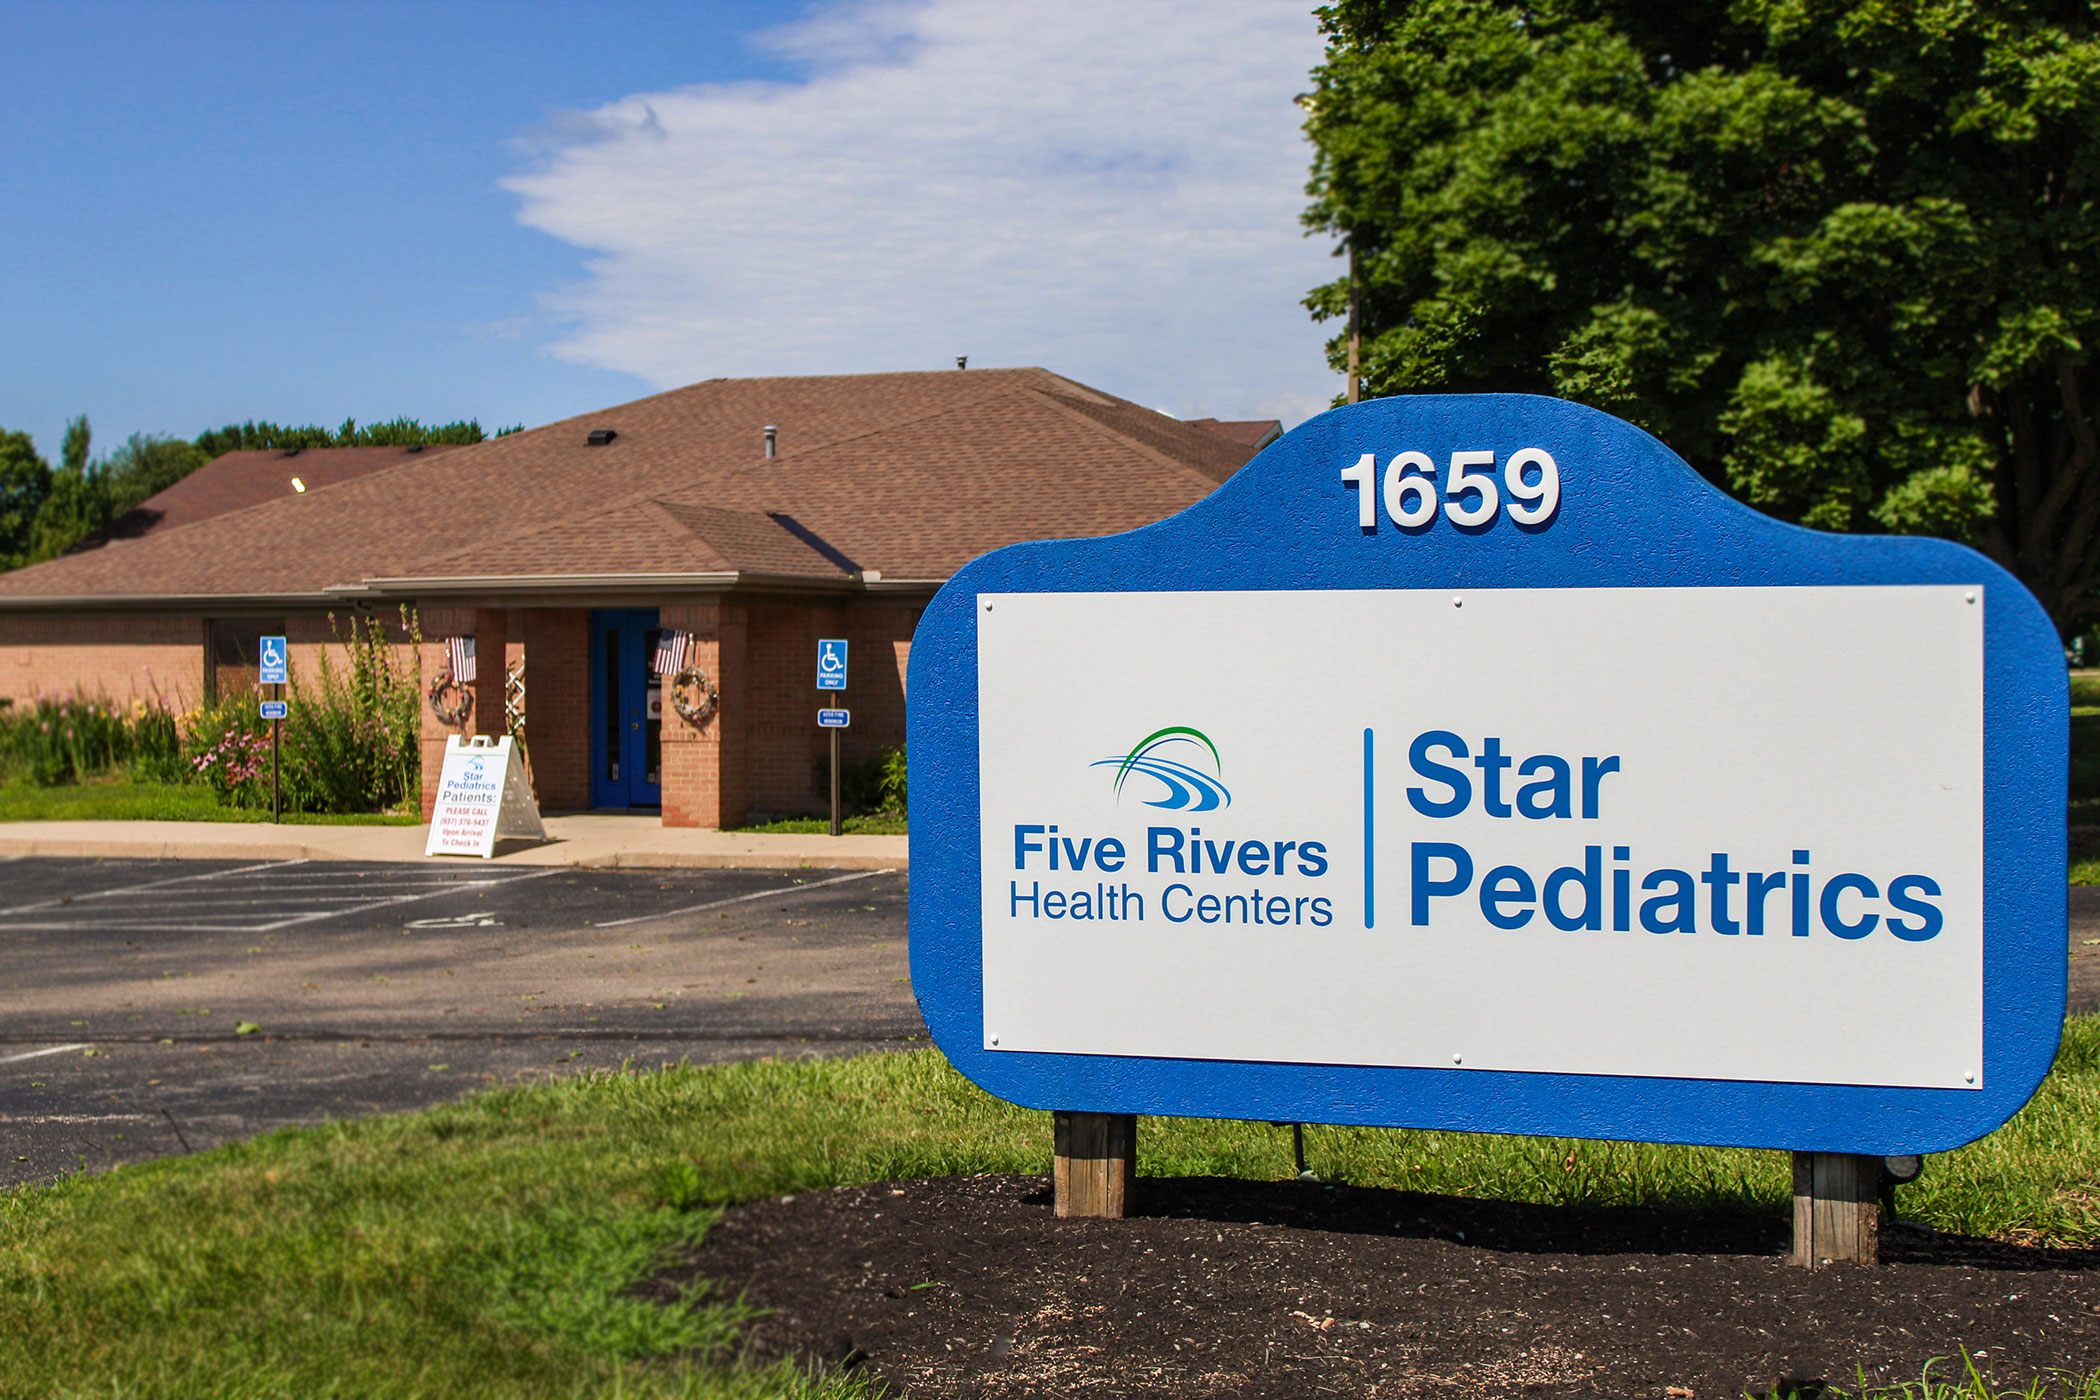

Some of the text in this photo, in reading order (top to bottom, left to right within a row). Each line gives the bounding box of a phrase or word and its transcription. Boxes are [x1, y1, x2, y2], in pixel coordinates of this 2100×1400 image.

[1340, 447, 1560, 527] 1659
[443, 790, 497, 804] Patients:
[447, 781, 496, 790] Pediatrics
[463, 771, 484, 781] Star
[1406, 731, 1621, 819] Star
[445, 807, 488, 816] PLEASE CALL
[1014, 824, 1329, 877] Five Rivers
[1010, 881, 1333, 927] Health Centers
[1411, 842, 1944, 942] Pediatrics
